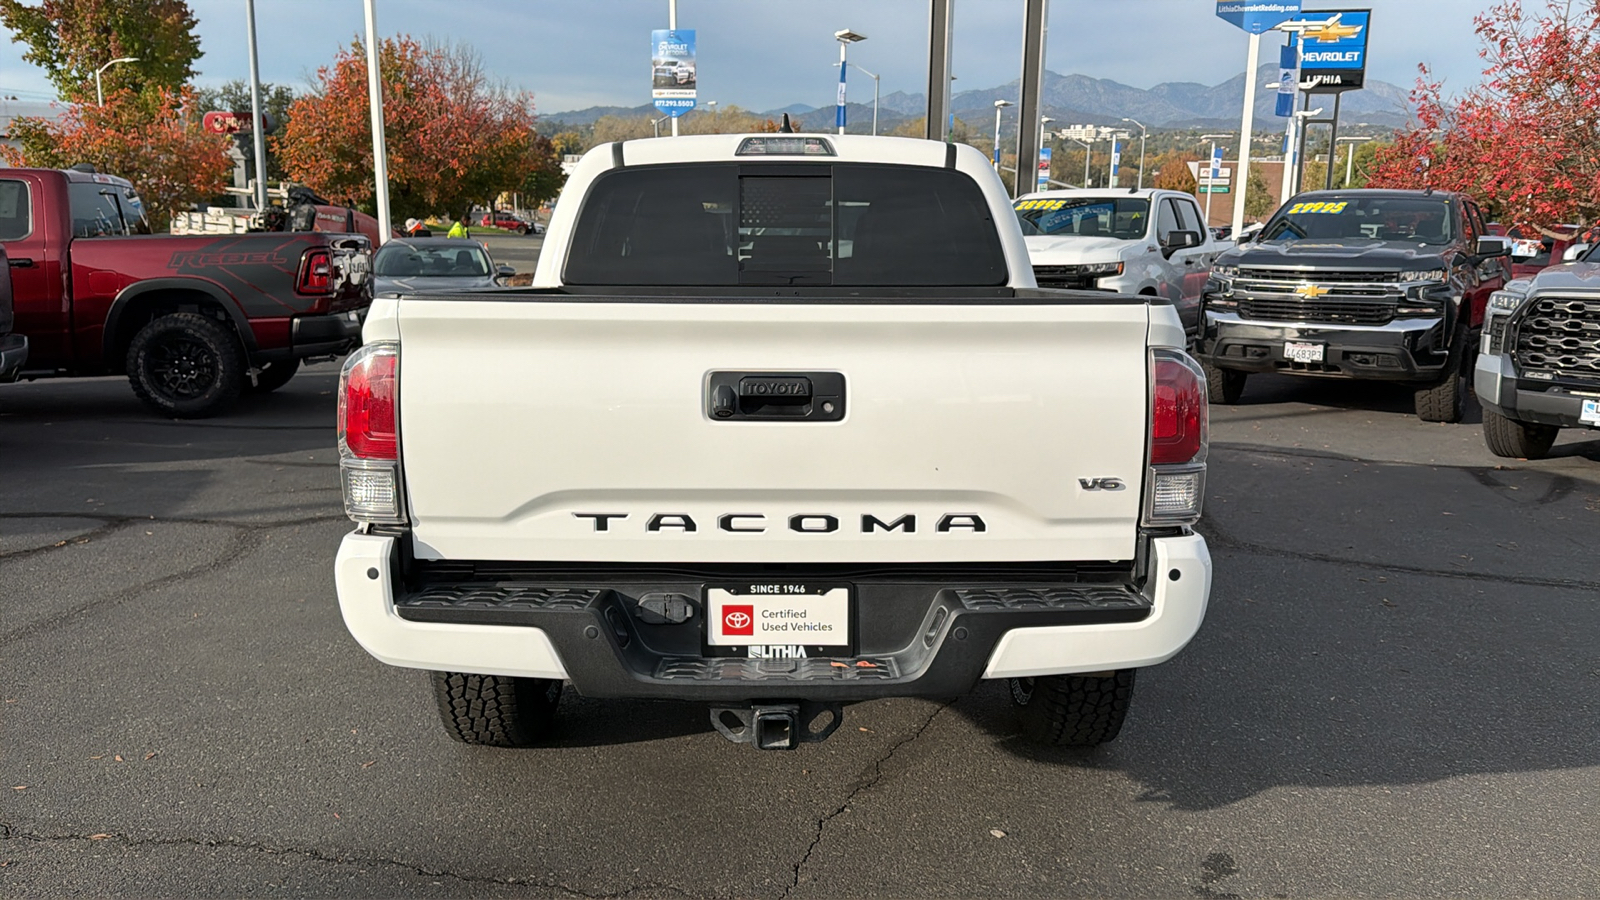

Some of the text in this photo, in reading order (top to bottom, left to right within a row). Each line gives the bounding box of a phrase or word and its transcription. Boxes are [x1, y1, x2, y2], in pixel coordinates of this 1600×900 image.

[1218, 4, 1299, 13] LithiaChevroletRedding.com
[1300, 51, 1360, 62] HEVROLET
[1015, 200, 1067, 210] 28995
[1287, 202, 1348, 214] 29995
[167, 251, 288, 269] REBEL
[745, 382, 807, 395] TOYOTA
[1078, 477, 1126, 491] V6
[571, 512, 988, 533] TACOMA
[750, 585, 806, 593] SINCE 1946
[761, 609, 807, 619] Certified
[761, 622, 833, 632] Used Vehicles
[761, 645, 807, 659] LITHIA
